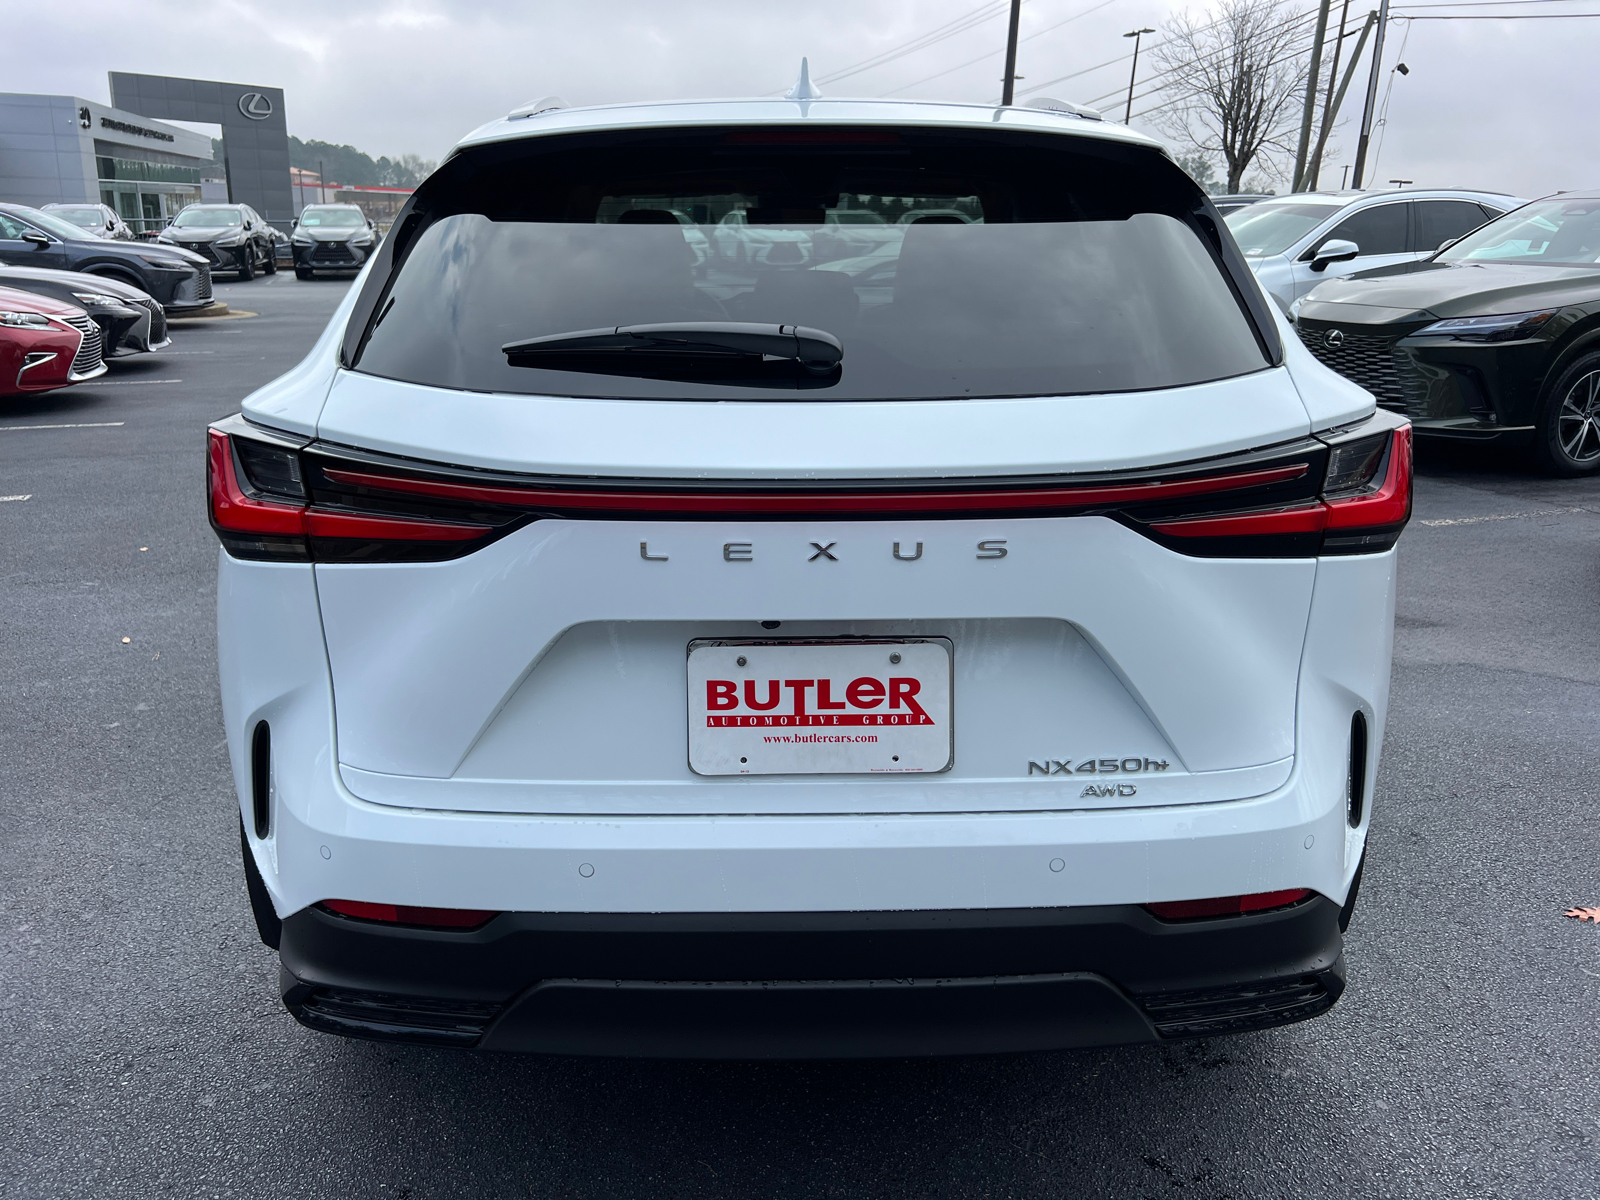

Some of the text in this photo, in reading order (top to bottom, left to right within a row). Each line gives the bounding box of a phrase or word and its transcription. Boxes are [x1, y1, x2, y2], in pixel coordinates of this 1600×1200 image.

[639, 539, 1008, 562] LEXUS
[708, 715, 926, 726] AUTOMOTIVE GROUP
[763, 733, 878, 744] www.butlercars.com
[1080, 783, 1137, 798] AWD
